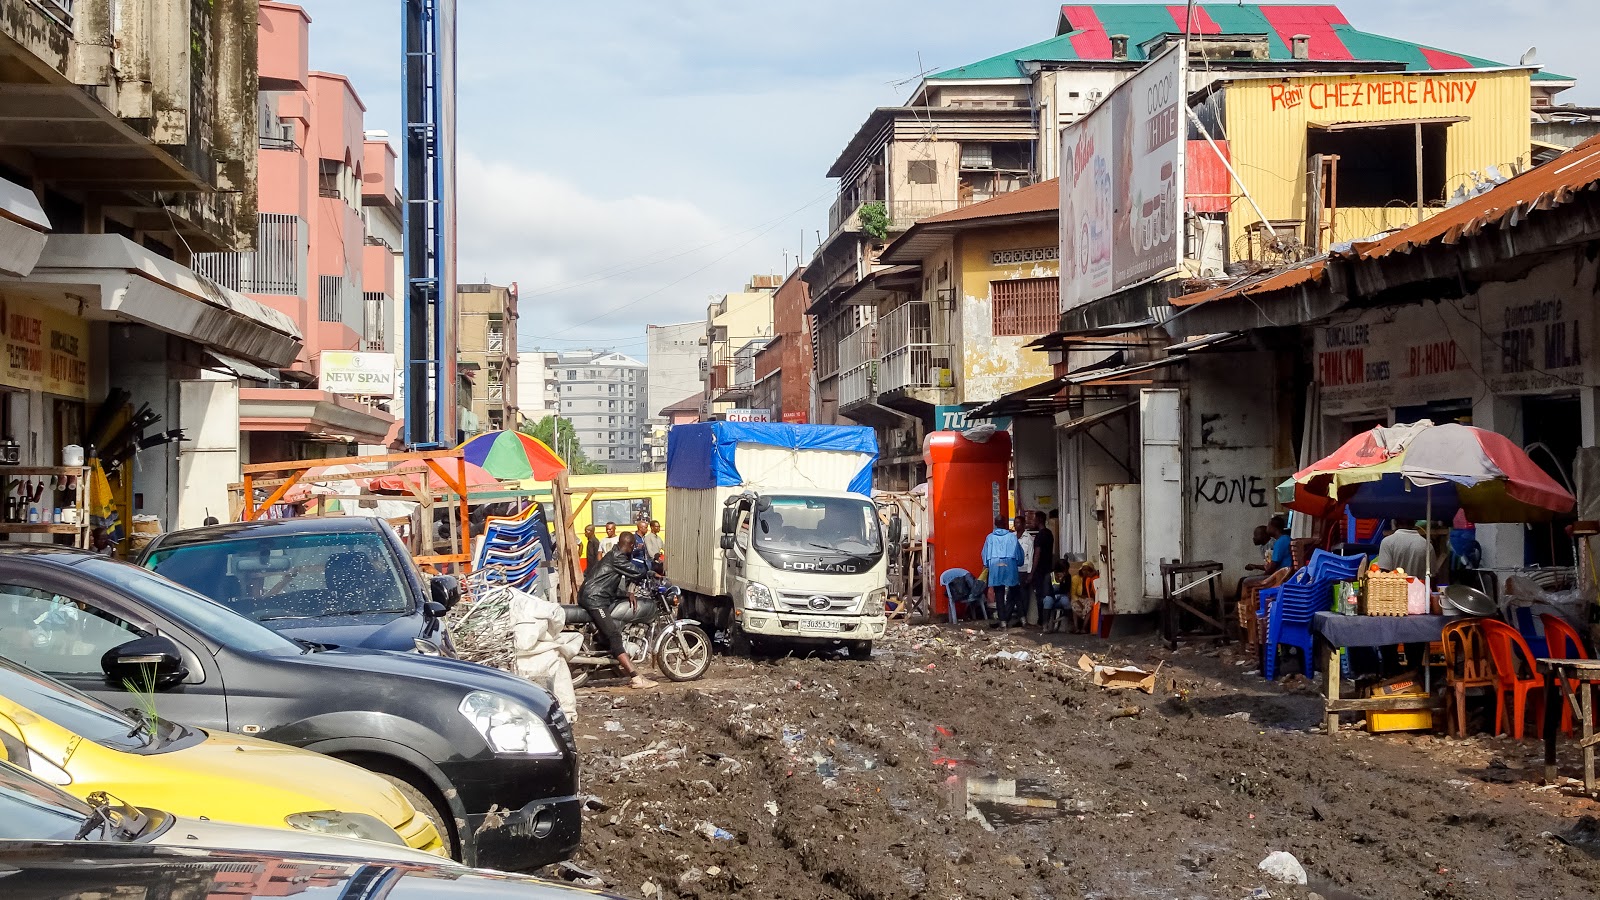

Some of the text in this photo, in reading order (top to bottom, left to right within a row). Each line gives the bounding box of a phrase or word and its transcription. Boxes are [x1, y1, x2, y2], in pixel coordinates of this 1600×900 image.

[1309, 82, 1364, 109] CHEZ
[1367, 81, 1418, 105] MERE
[1423, 78, 1477, 104] ANNY
[1146, 106, 1175, 151] WHITE
[1319, 350, 1344, 387] EMMA
[1345, 348, 1364, 384] COM
[1502, 328, 1535, 374] ERIC
[326, 372, 390, 383] NEW SPAN
[729, 414, 767, 422] Clotek
[1194, 474, 1268, 507] KONE
